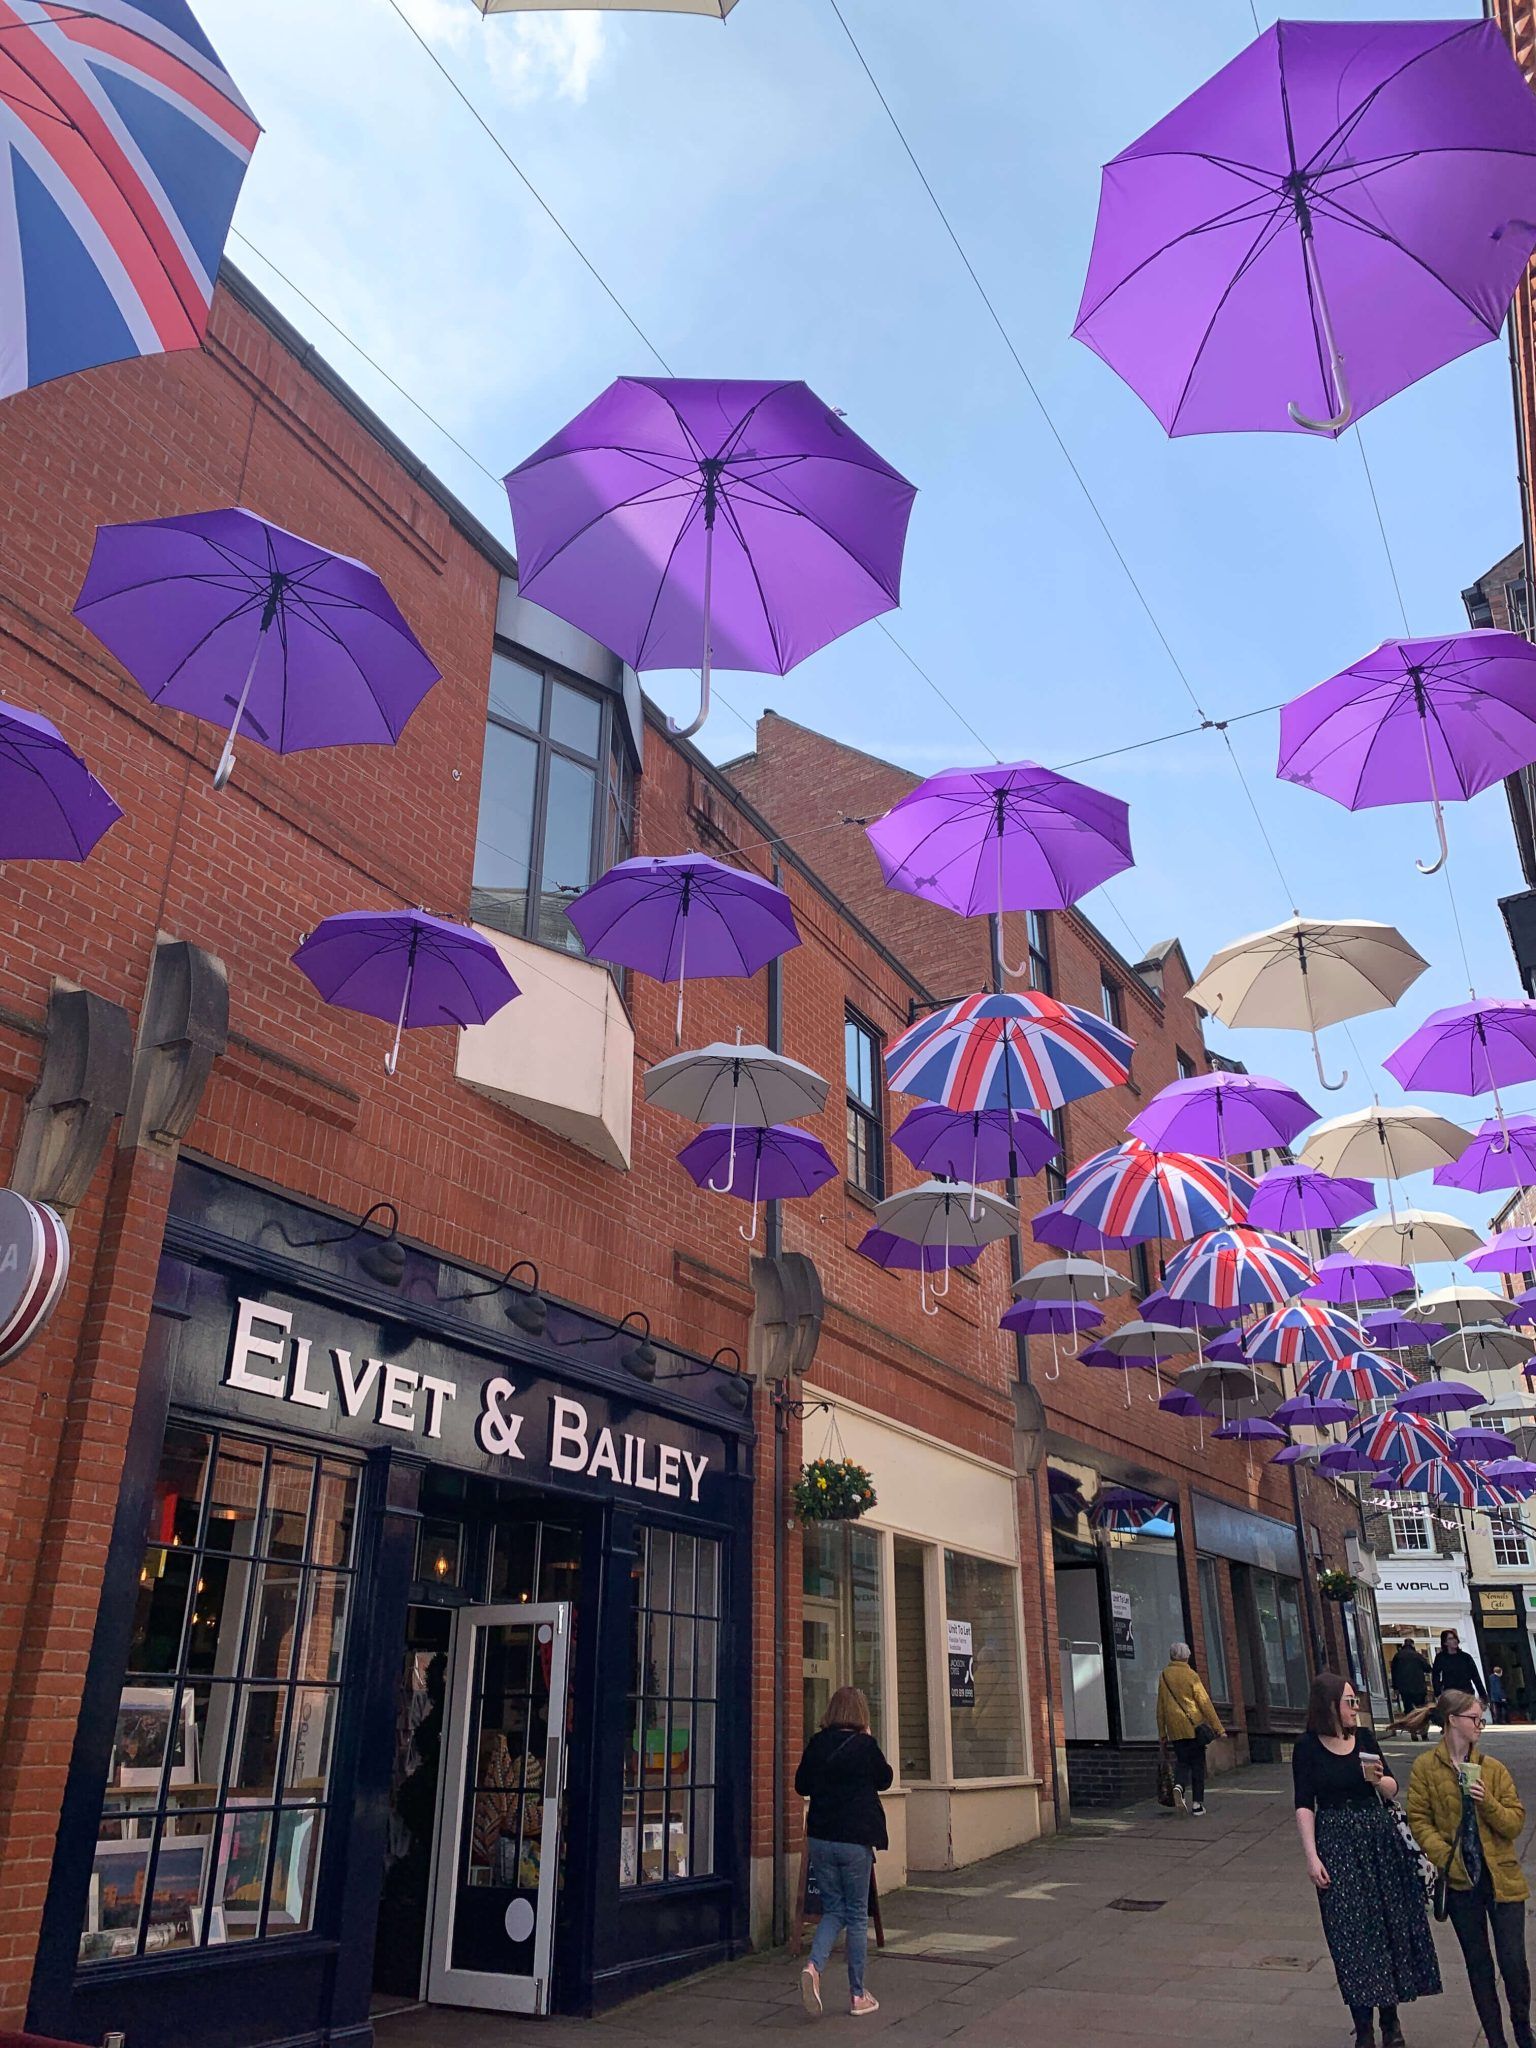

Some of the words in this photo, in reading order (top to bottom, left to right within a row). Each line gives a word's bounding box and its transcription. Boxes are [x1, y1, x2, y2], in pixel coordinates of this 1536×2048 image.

[226, 1297, 457, 1439] ELVET
[480, 1377, 525, 1460] &
[549, 1395, 709, 1502] BAILEY
[1396, 1582, 1449, 1591] WORLD
[948, 1624, 957, 1634] Unit
[958, 1625, 963, 1635] To
